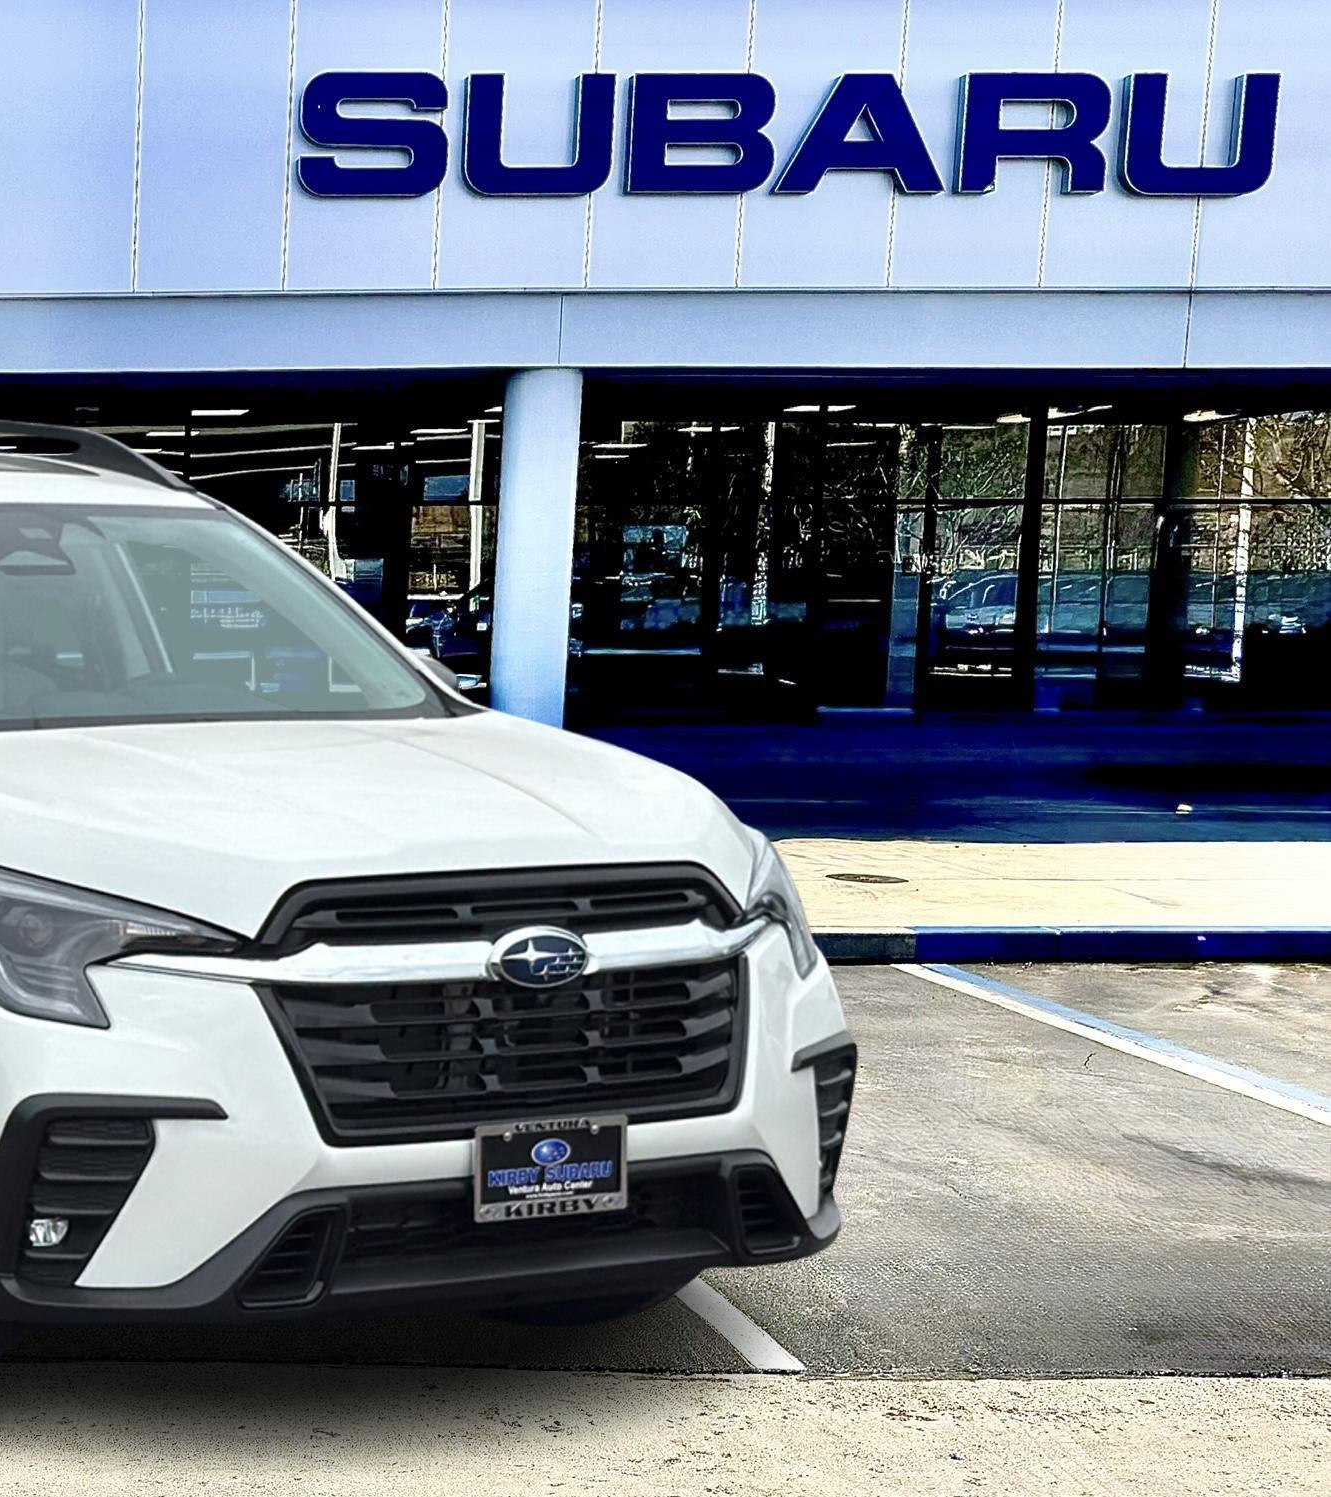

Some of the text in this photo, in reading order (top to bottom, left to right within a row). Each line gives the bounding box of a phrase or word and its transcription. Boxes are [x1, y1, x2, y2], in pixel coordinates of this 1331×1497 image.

[296, 69, 1281, 198] SUBARU
[514, 1118, 591, 1132] VENTURA
[488, 1160, 613, 1187] KIRBY SUBARU
[508, 1184, 540, 1195] Ventura
[541, 1182, 563, 1192] Auto
[564, 1180, 593, 1190] Center
[504, 1196, 598, 1217] KIRBY
